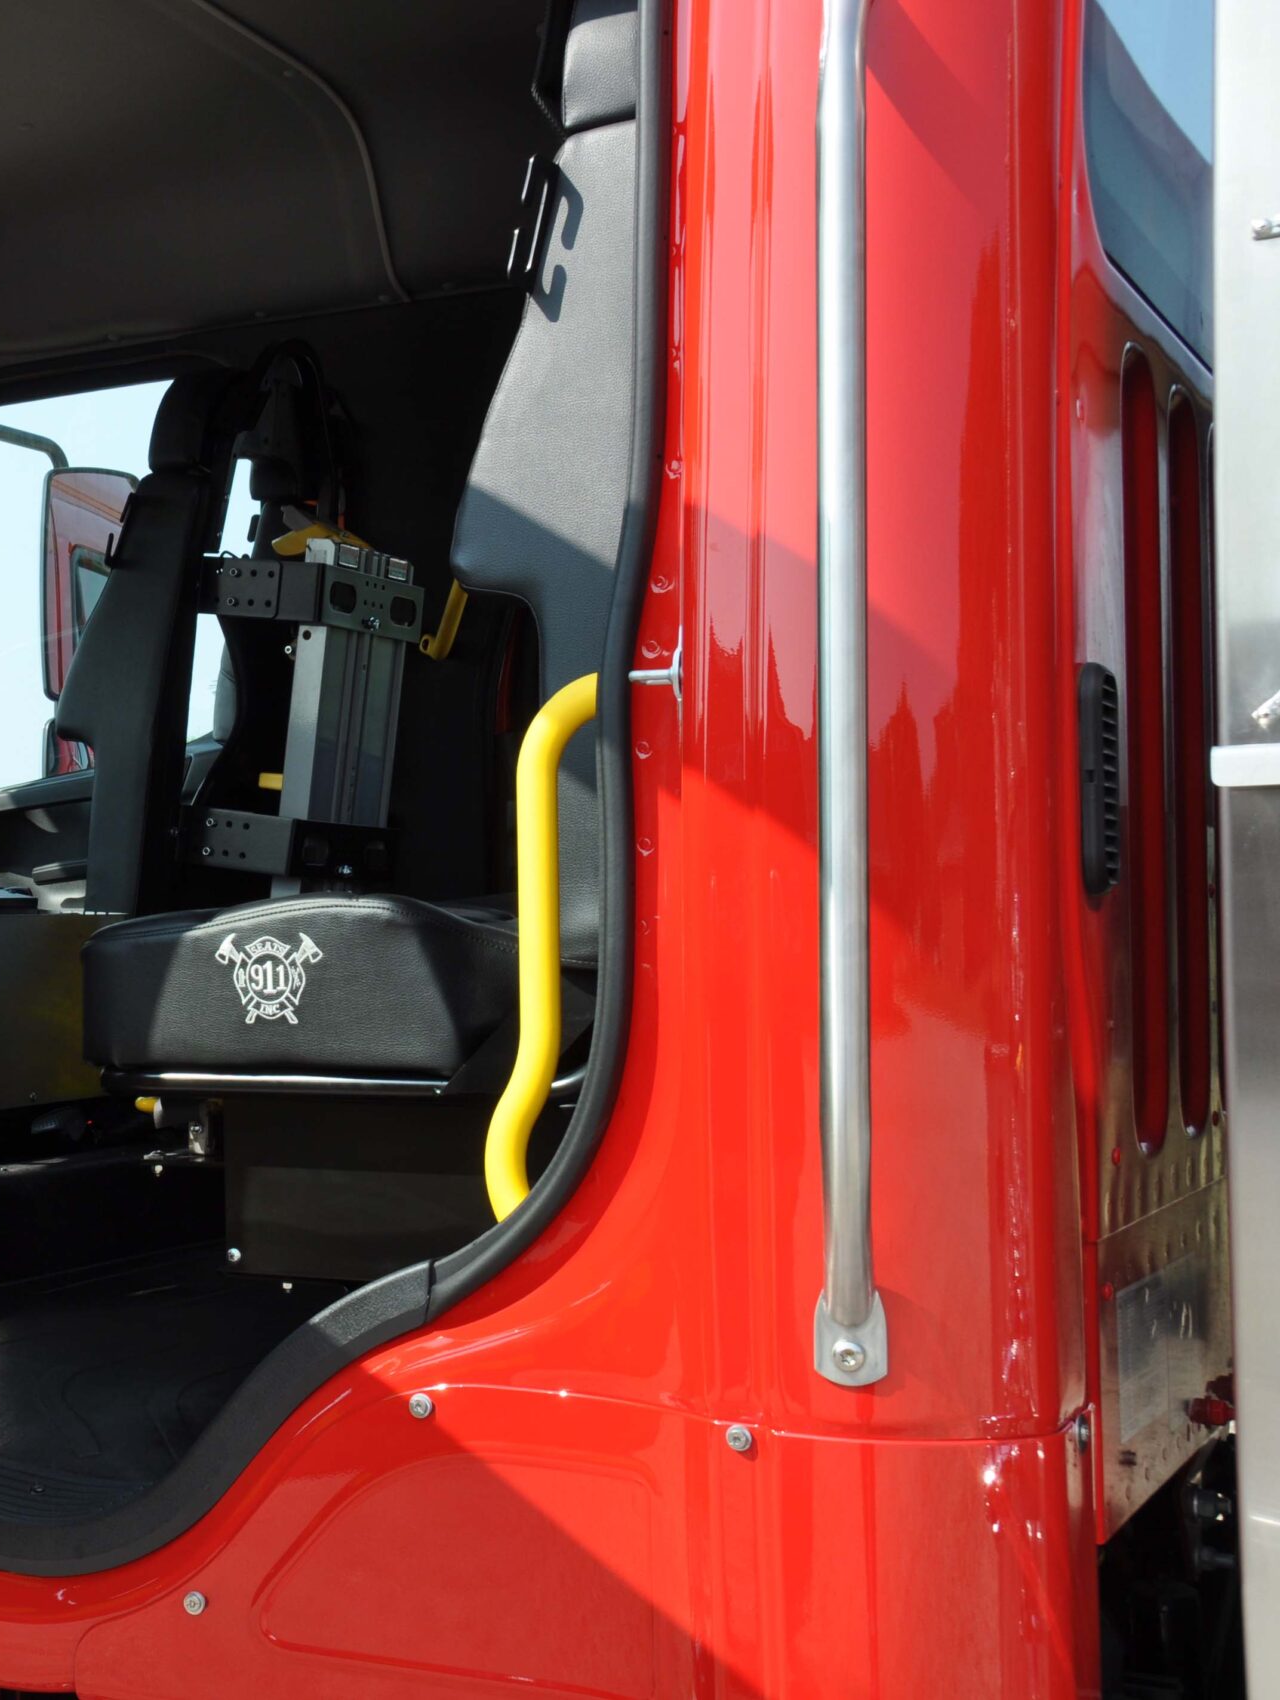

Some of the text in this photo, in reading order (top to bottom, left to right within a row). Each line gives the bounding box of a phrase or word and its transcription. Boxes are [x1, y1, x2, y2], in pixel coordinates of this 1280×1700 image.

[250, 940, 285, 954] SEATS
[250, 960, 288, 994] 911
[259, 1003, 281, 1015] INC
